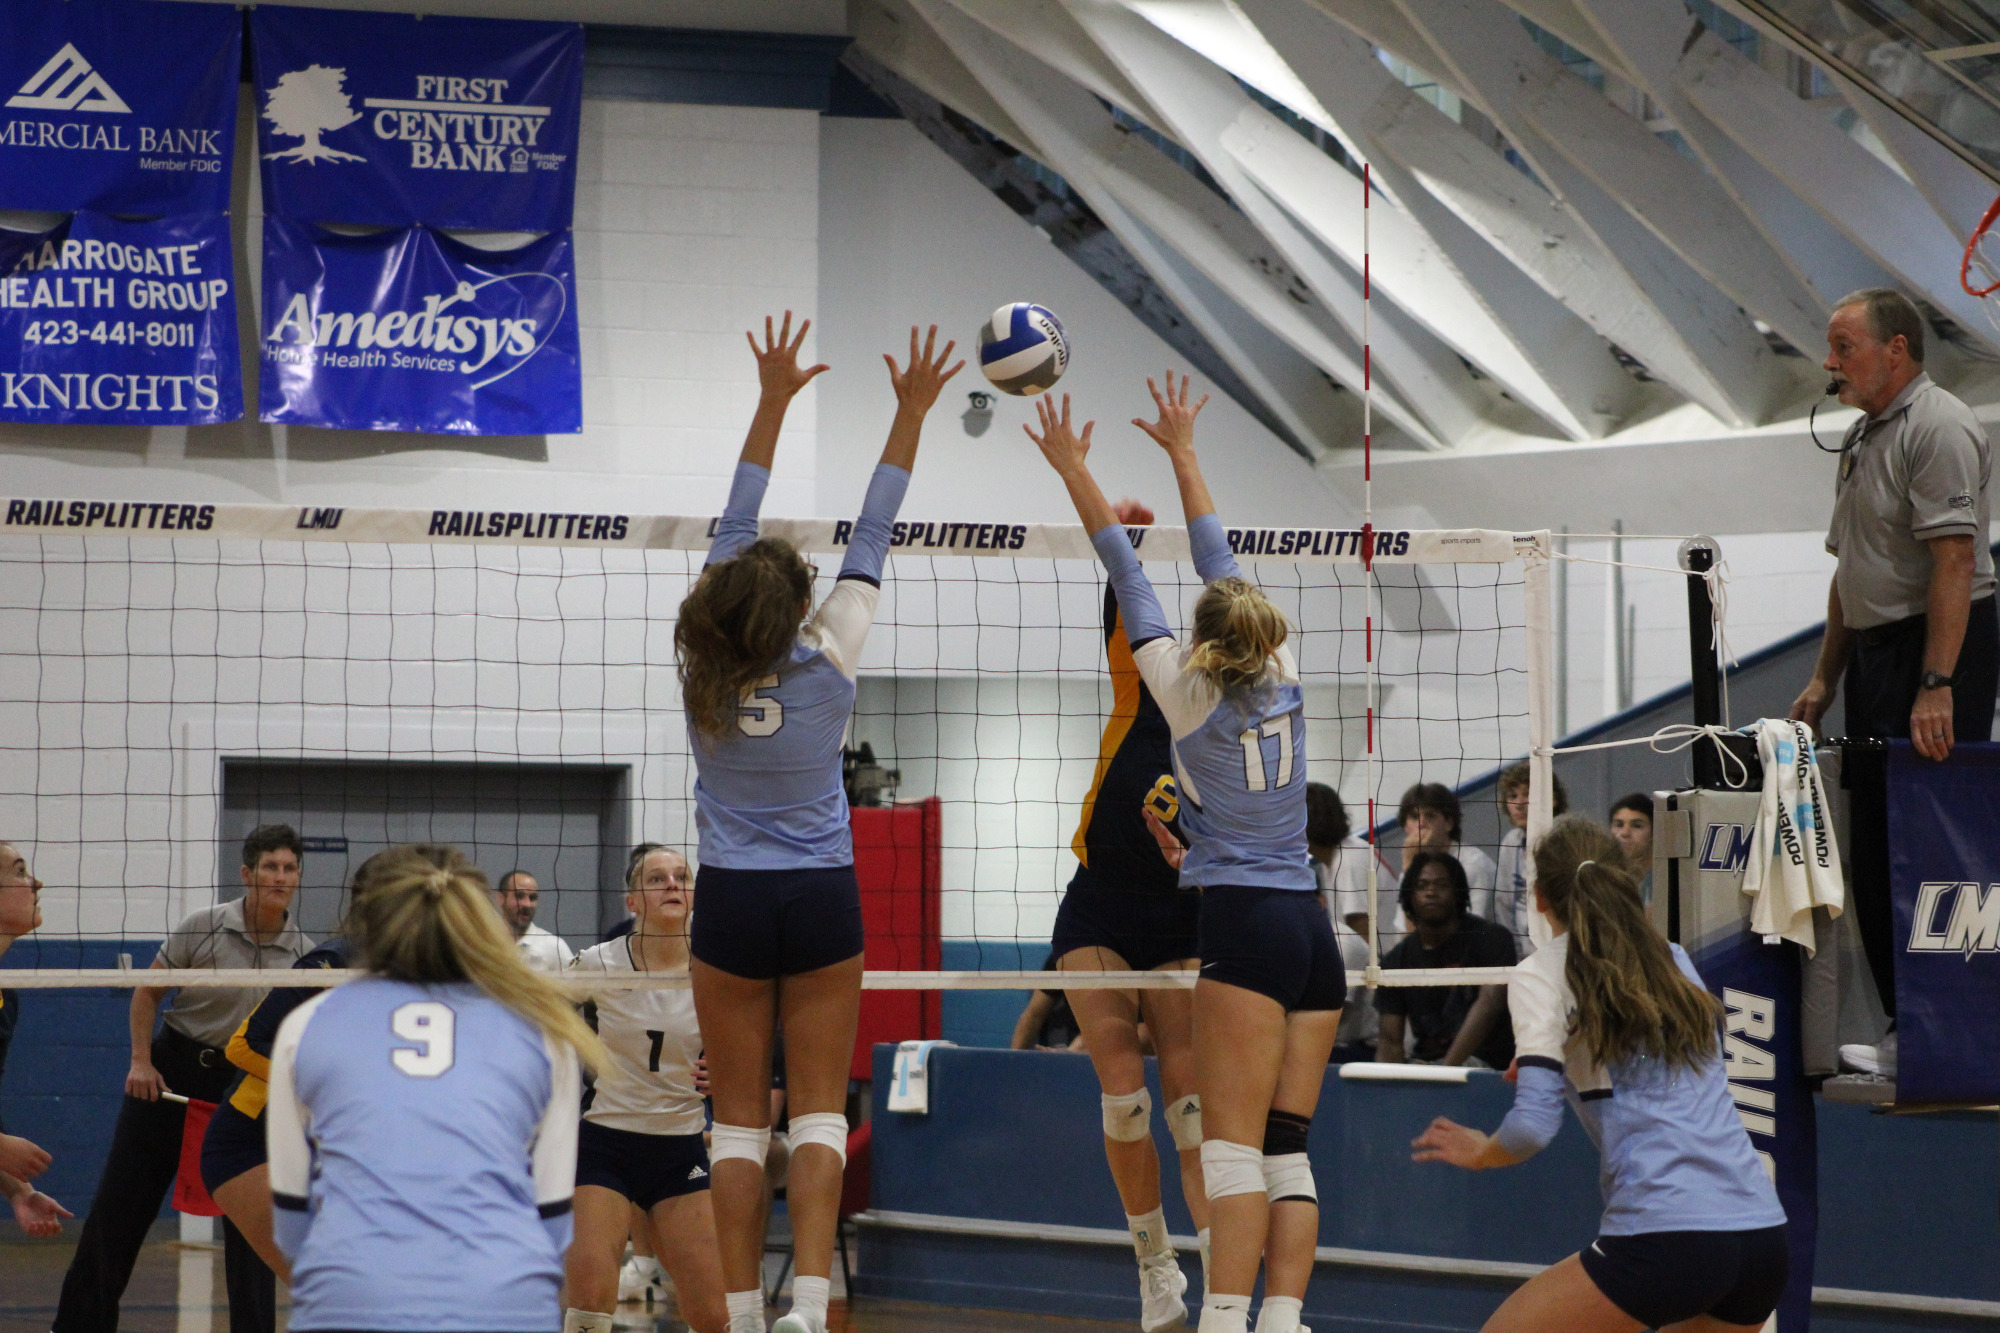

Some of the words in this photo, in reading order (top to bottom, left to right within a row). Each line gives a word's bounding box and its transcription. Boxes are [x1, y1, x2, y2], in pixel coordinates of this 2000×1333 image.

[416, 75, 509, 103] FIRST
[139, 126, 223, 155] BANK
[373, 110, 545, 146] CENTURY
[140, 157, 188, 172] Member
[190, 159, 222, 173] FDIC
[411, 141, 507, 173] BANK
[537, 161, 559, 171] FDIC
[128, 278, 228, 311] GROUP
[24, 320, 195, 347] 423-441-8011
[267, 292, 537, 374] Amedisys
[1039, 318, 1065, 367] molten
[323, 351, 386, 368] Health
[391, 351, 456, 372] Services
[1, 372, 219, 412] KNIGHTS
[6, 500, 215, 530] RAILSPLITTERS
[296, 507, 345, 530] LMU
[428, 511, 629, 540] RAILSPLITTERS
[1227, 530, 1411, 556] RAILSPLITTRS
[738, 672, 784, 738] 5
[1238, 712, 1295, 792] 17
[1143, 774, 1179, 823] 8
[1699, 823, 1755, 877] LM
[1907, 881, 2000, 962] LM
[390, 1001, 456, 1078] 9
[646, 1029, 665, 1072] 1
